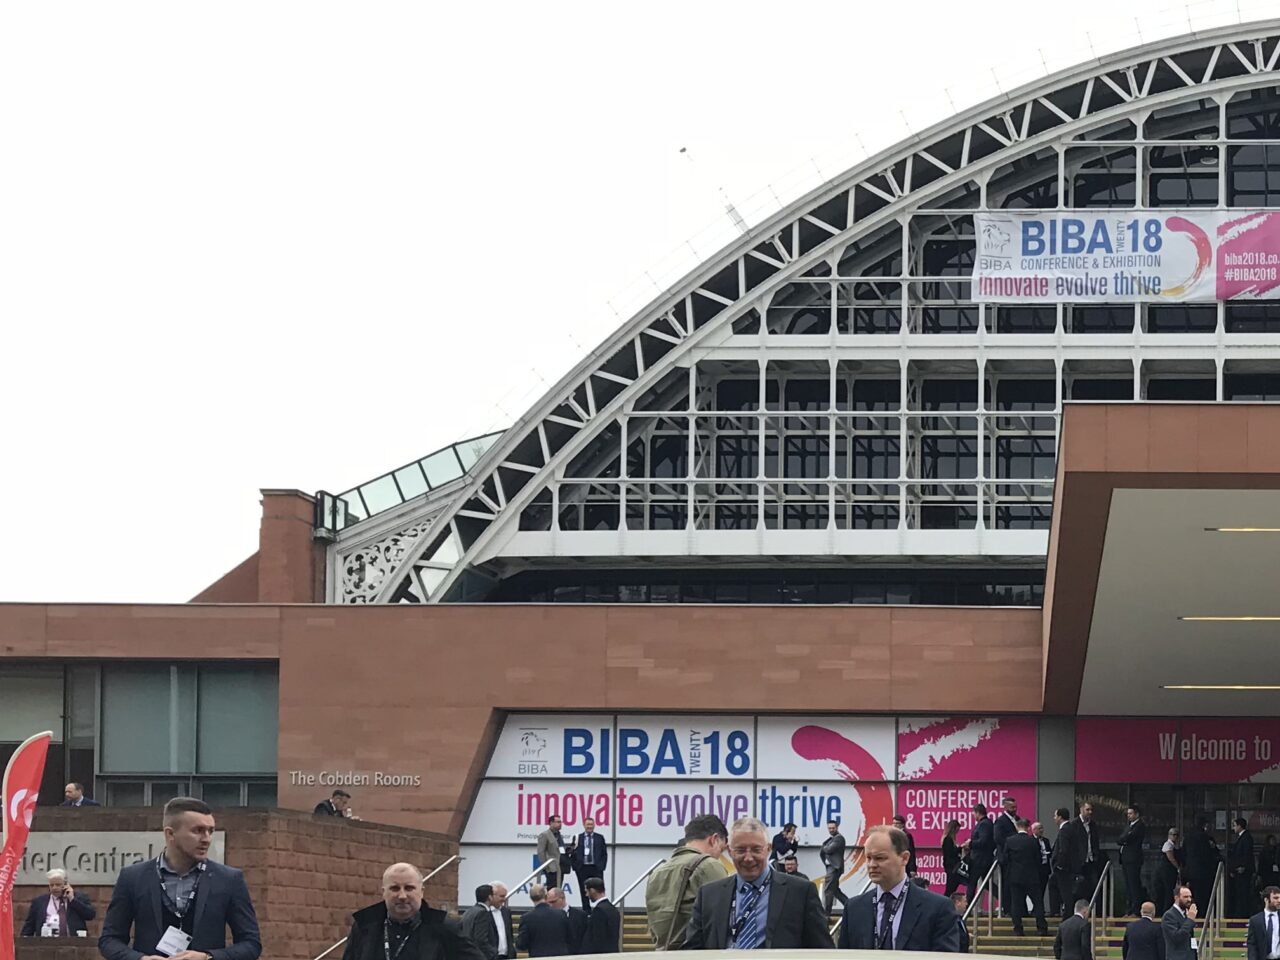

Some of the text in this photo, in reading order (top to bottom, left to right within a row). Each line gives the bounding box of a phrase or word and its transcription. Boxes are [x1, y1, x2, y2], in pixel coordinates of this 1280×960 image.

[1021, 218, 1163, 256] BIBA TWENTY 18
[979, 259, 1012, 271] BIBA
[1020, 255, 1161, 270] CONFERENCE & EXHIBITION
[979, 270, 1162, 297] innovate evolve thrive
[1224, 268, 1277, 281] #BIBA2018
[563, 728, 750, 776] BIBA TWENTY 18
[1159, 732, 1272, 760] Welcome to
[518, 763, 548, 774] BIBA
[289, 770, 421, 787] The Cobden Rooms
[517, 784, 842, 828] innovate evolve thrive
[906, 790, 1008, 808] CONFERENCE
[906, 812, 917, 830] &
[62, 844, 153, 872] Central
